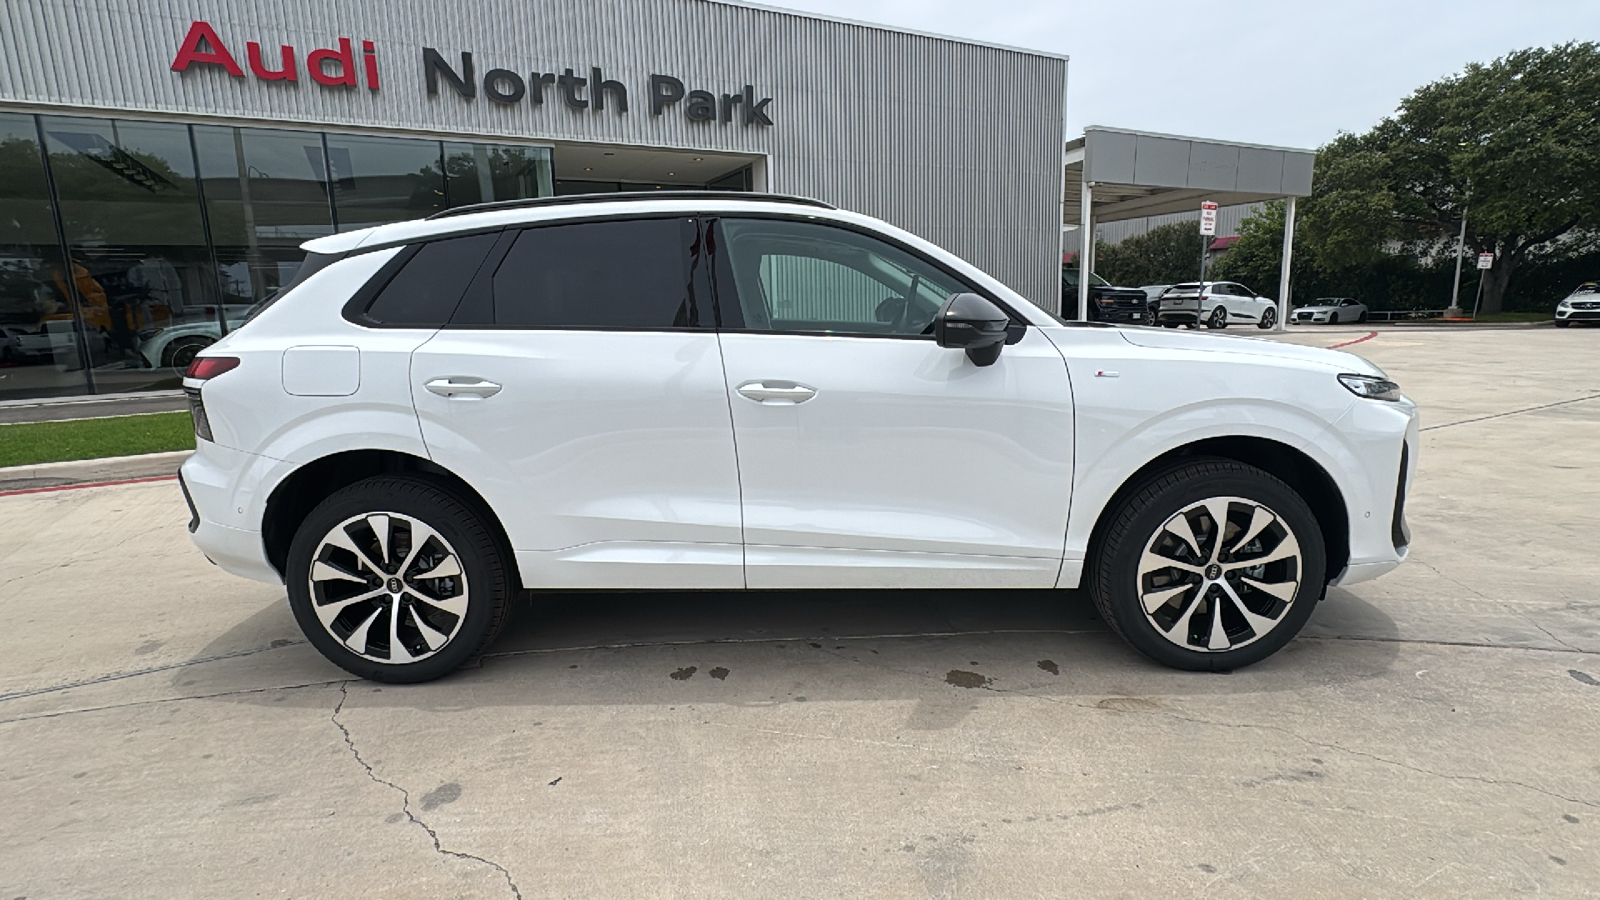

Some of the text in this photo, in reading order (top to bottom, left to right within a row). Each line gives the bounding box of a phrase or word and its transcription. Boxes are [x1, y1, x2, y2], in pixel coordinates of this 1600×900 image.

[170, 20, 774, 127] Audi North Park
